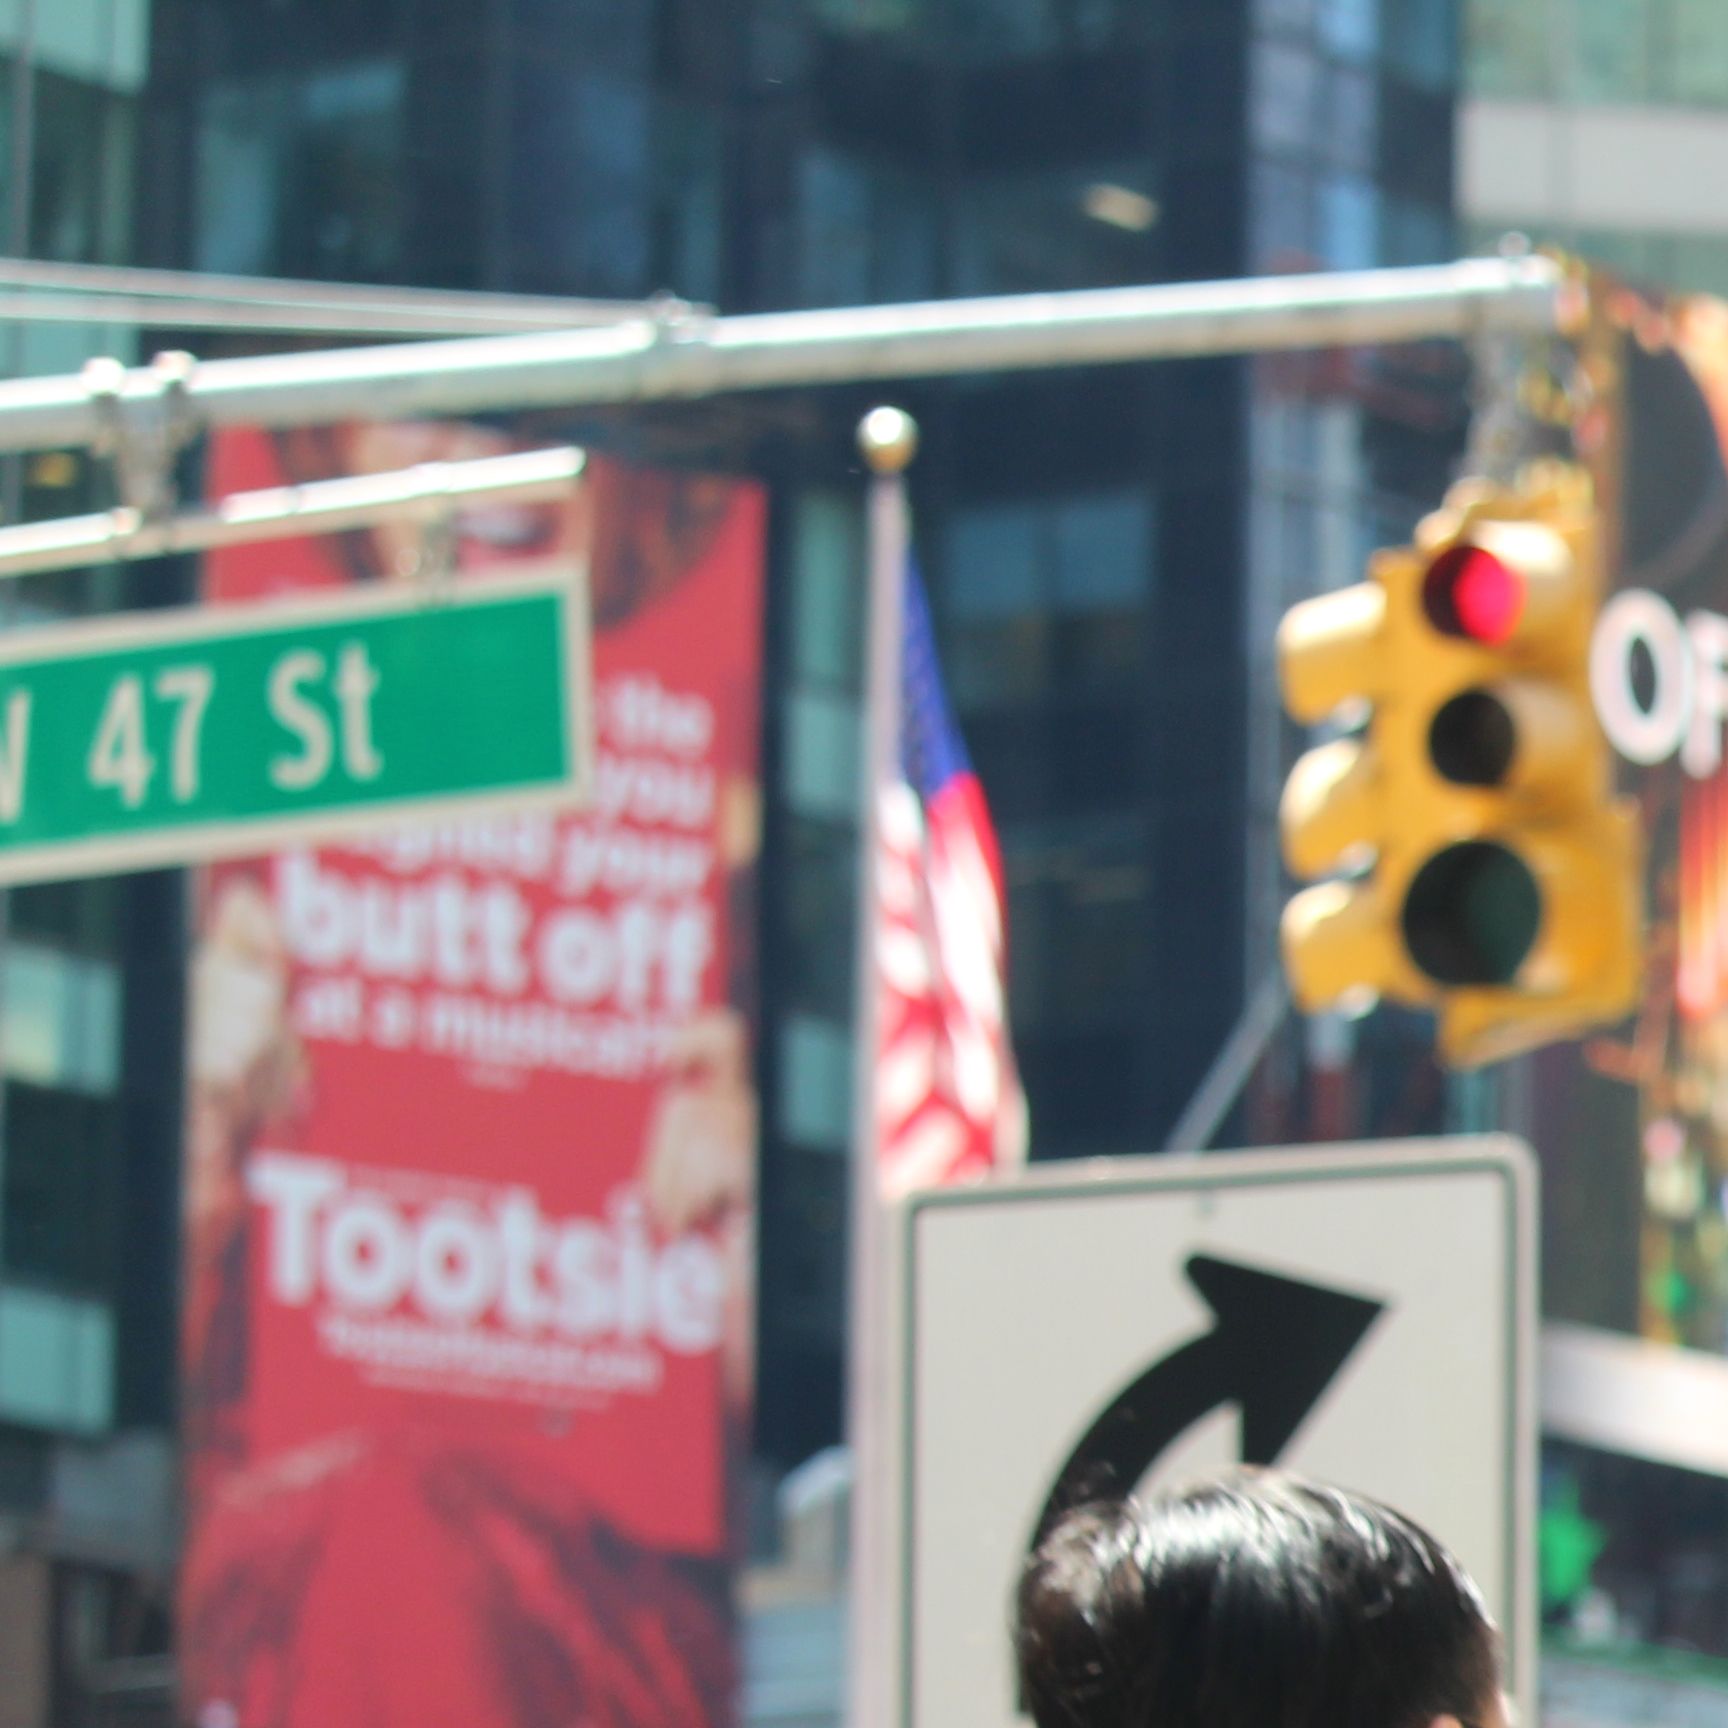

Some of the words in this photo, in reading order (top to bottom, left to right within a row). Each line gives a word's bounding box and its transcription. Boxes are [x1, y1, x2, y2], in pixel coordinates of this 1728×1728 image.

[87, 663, 215, 810] 47
[267, 638, 384, 792] St
[610, 670, 713, 756] the
[279, 845, 534, 998] butt
[538, 898, 714, 1018] off
[245, 1148, 722, 1353] Tootsie
